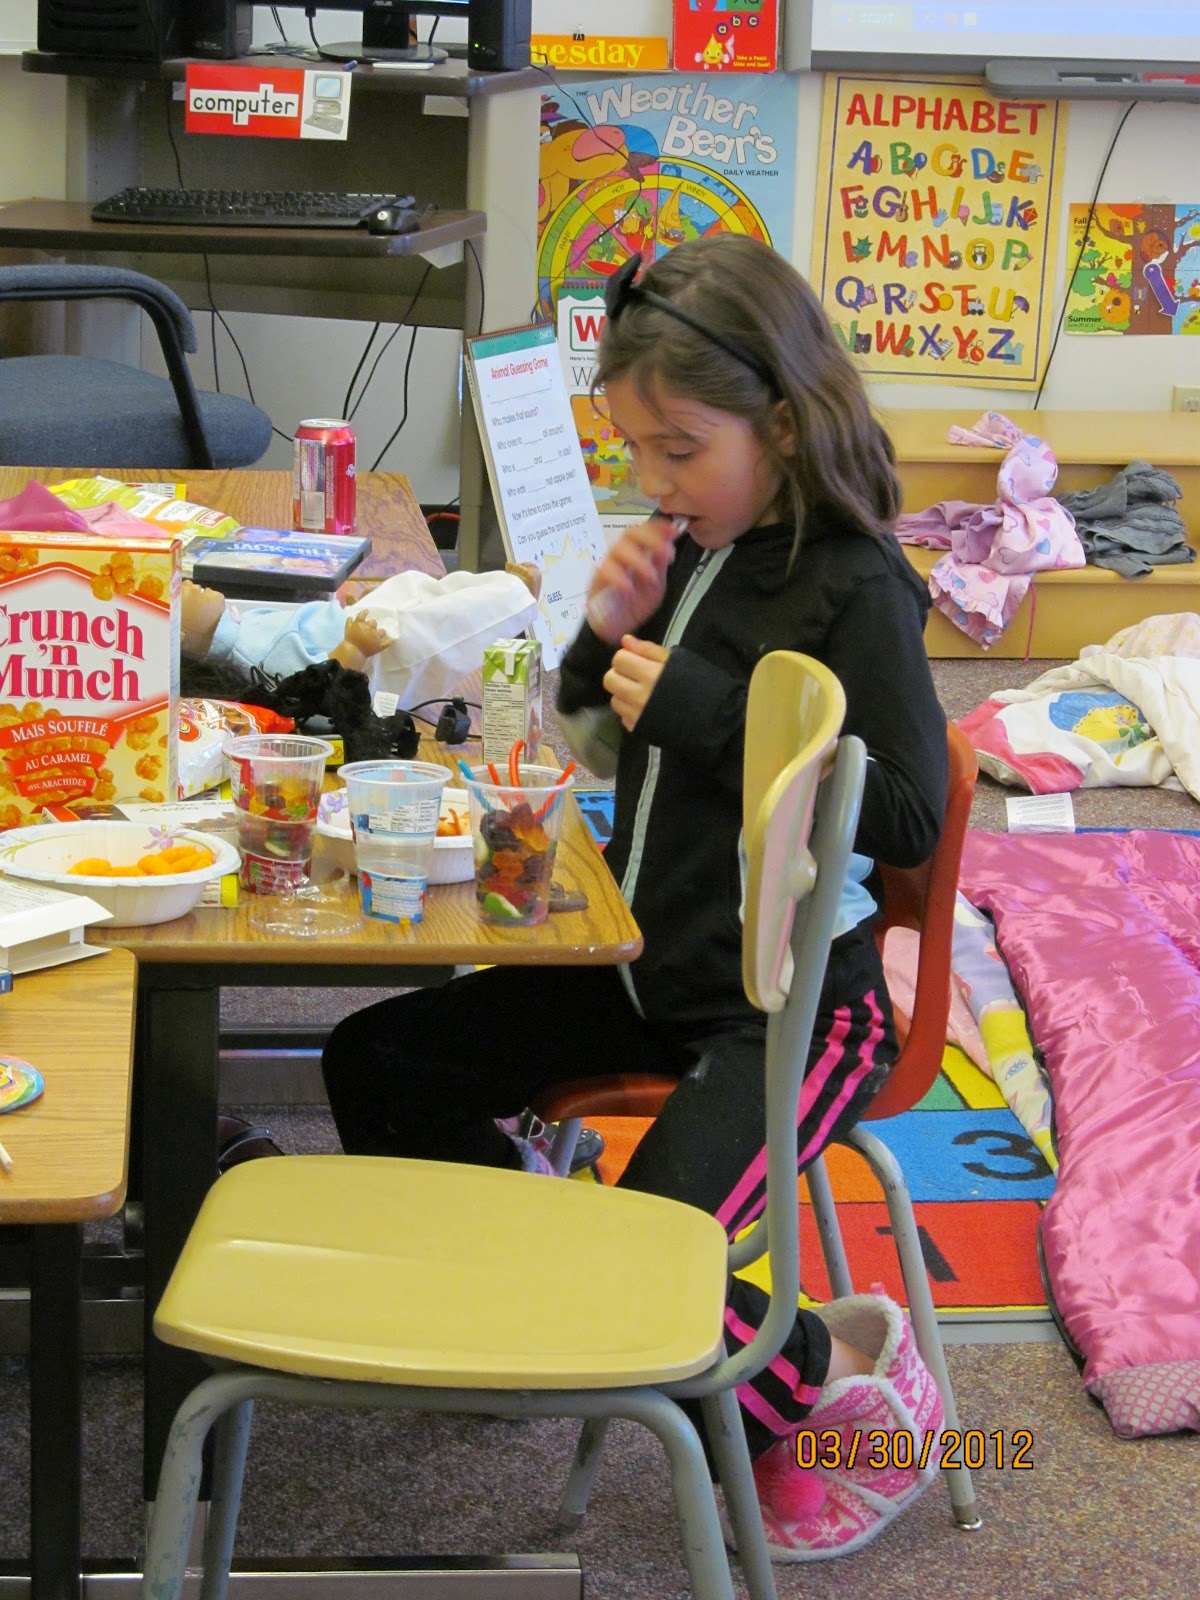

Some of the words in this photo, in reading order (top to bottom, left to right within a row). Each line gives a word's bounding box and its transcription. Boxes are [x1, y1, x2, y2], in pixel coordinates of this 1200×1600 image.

[732, 16, 741, 26] b
[749, 17, 757, 26] c
[530, 39, 645, 68] uesday
[193, 89, 295, 123] computer
[586, 81, 759, 130] Weather
[845, 93, 1047, 136] ALPHABET
[661, 114, 778, 165] Bear's
[723, 169, 744, 177] DAILY
[745, 169, 779, 177] WEATHER
[847, 140, 872, 175] A
[889, 141, 915, 175] B
[931, 143, 959, 176] C
[971, 147, 995, 179] D
[1008, 149, 1034, 183] E
[611, 184, 626, 195] HOT
[686, 184, 708, 197] WINDY
[841, 184, 864, 219] F
[872, 185, 902, 218] G
[911, 185, 938, 221] H
[972, 191, 992, 225] J
[1006, 195, 1034, 230] K
[1074, 217, 1087, 225] Fall
[876, 230, 909, 268] M
[921, 234, 950, 268] N
[965, 237, 995, 270] O
[1001, 238, 1029, 270] P
[835, 275, 865, 313] Q
[883, 282, 909, 315] R
[919, 281, 945, 314] S
[952, 284, 977, 316] T
[987, 286, 1016, 322] U
[574, 315, 606, 342] W
[1068, 315, 1102, 323] Summer
[876, 320, 911, 355] W
[918, 323, 944, 356] X
[952, 326, 978, 359] Y
[987, 327, 1016, 360] Z
[491, 365, 509, 380] Animal
[510, 360, 534, 376] Guessing
[533, 357, 548, 370] Game
[492, 418, 502, 426] Who
[502, 413, 516, 424] makes
[516, 410, 524, 420] that
[497, 441, 507, 450] Who
[502, 464, 512, 473] Who
[534, 455, 543, 465] and
[507, 488, 516, 497] Who
[512, 512, 522, 520] Now
[542, 502, 552, 512] play
[518, 535, 528, 545] Can
[527, 532, 536, 543] you
[536, 528, 548, 541] guess
[573, 513, 587, 526] name?
[11, 723, 46, 743] MAÏS
[48, 720, 109, 737] SOUFFLÉ
[25, 759, 39, 771] AU
[41, 752, 92, 767] CARAMEL
[27, 782, 41, 791] AVEC
[42, 778, 87, 790] ARACHIDES
[951, 1129, 1055, 1181] 3
